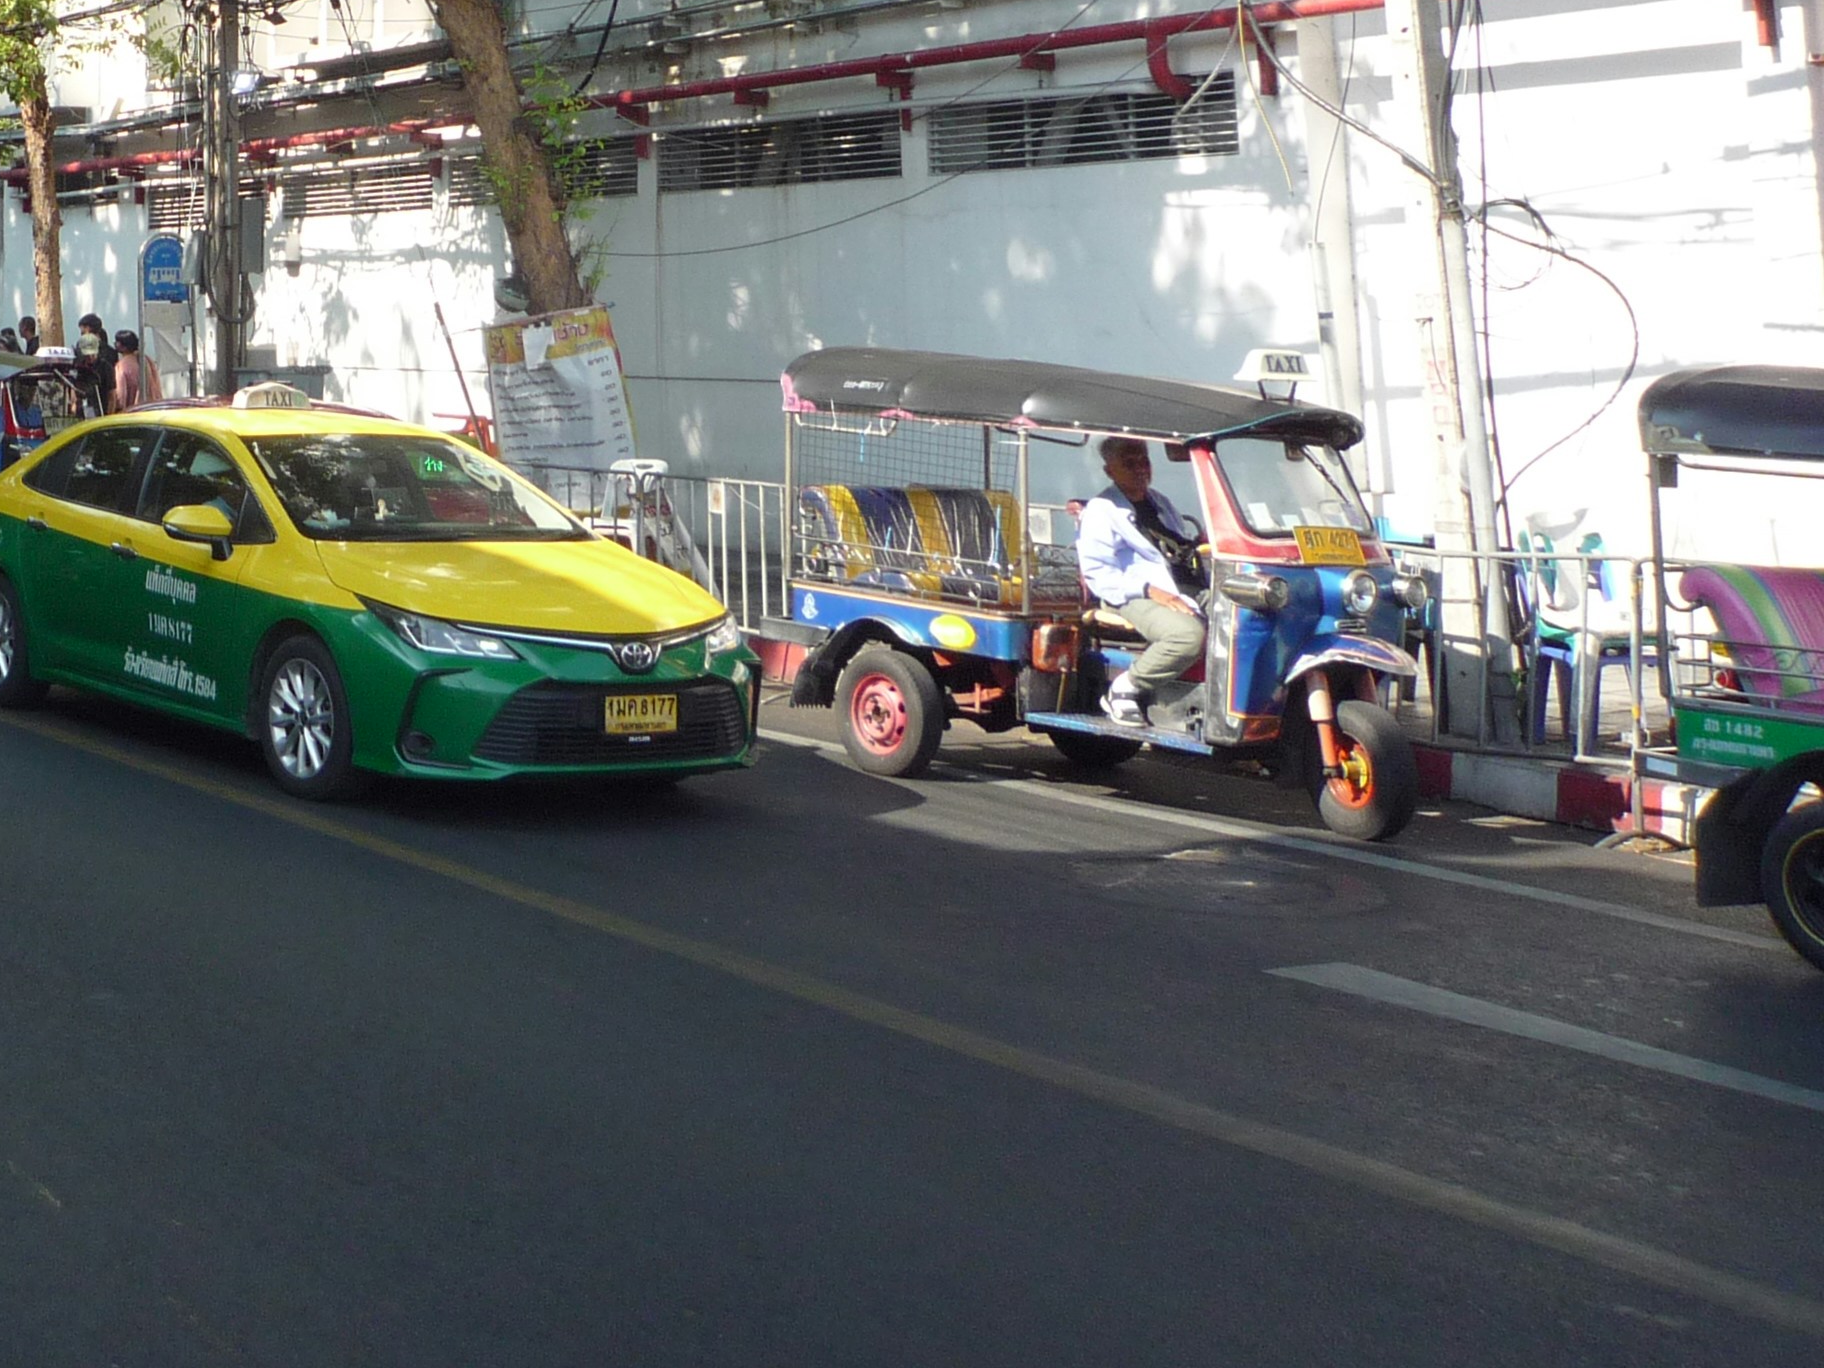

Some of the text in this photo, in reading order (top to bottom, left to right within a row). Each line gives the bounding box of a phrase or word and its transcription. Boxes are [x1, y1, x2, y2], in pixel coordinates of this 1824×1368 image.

[1264, 354, 1304, 374] TAXI
[265, 390, 293, 407] TAXI
[145, 564, 197, 605] แท็กซี่บุคคล
[608, 697, 675, 717] 1มค 8177
